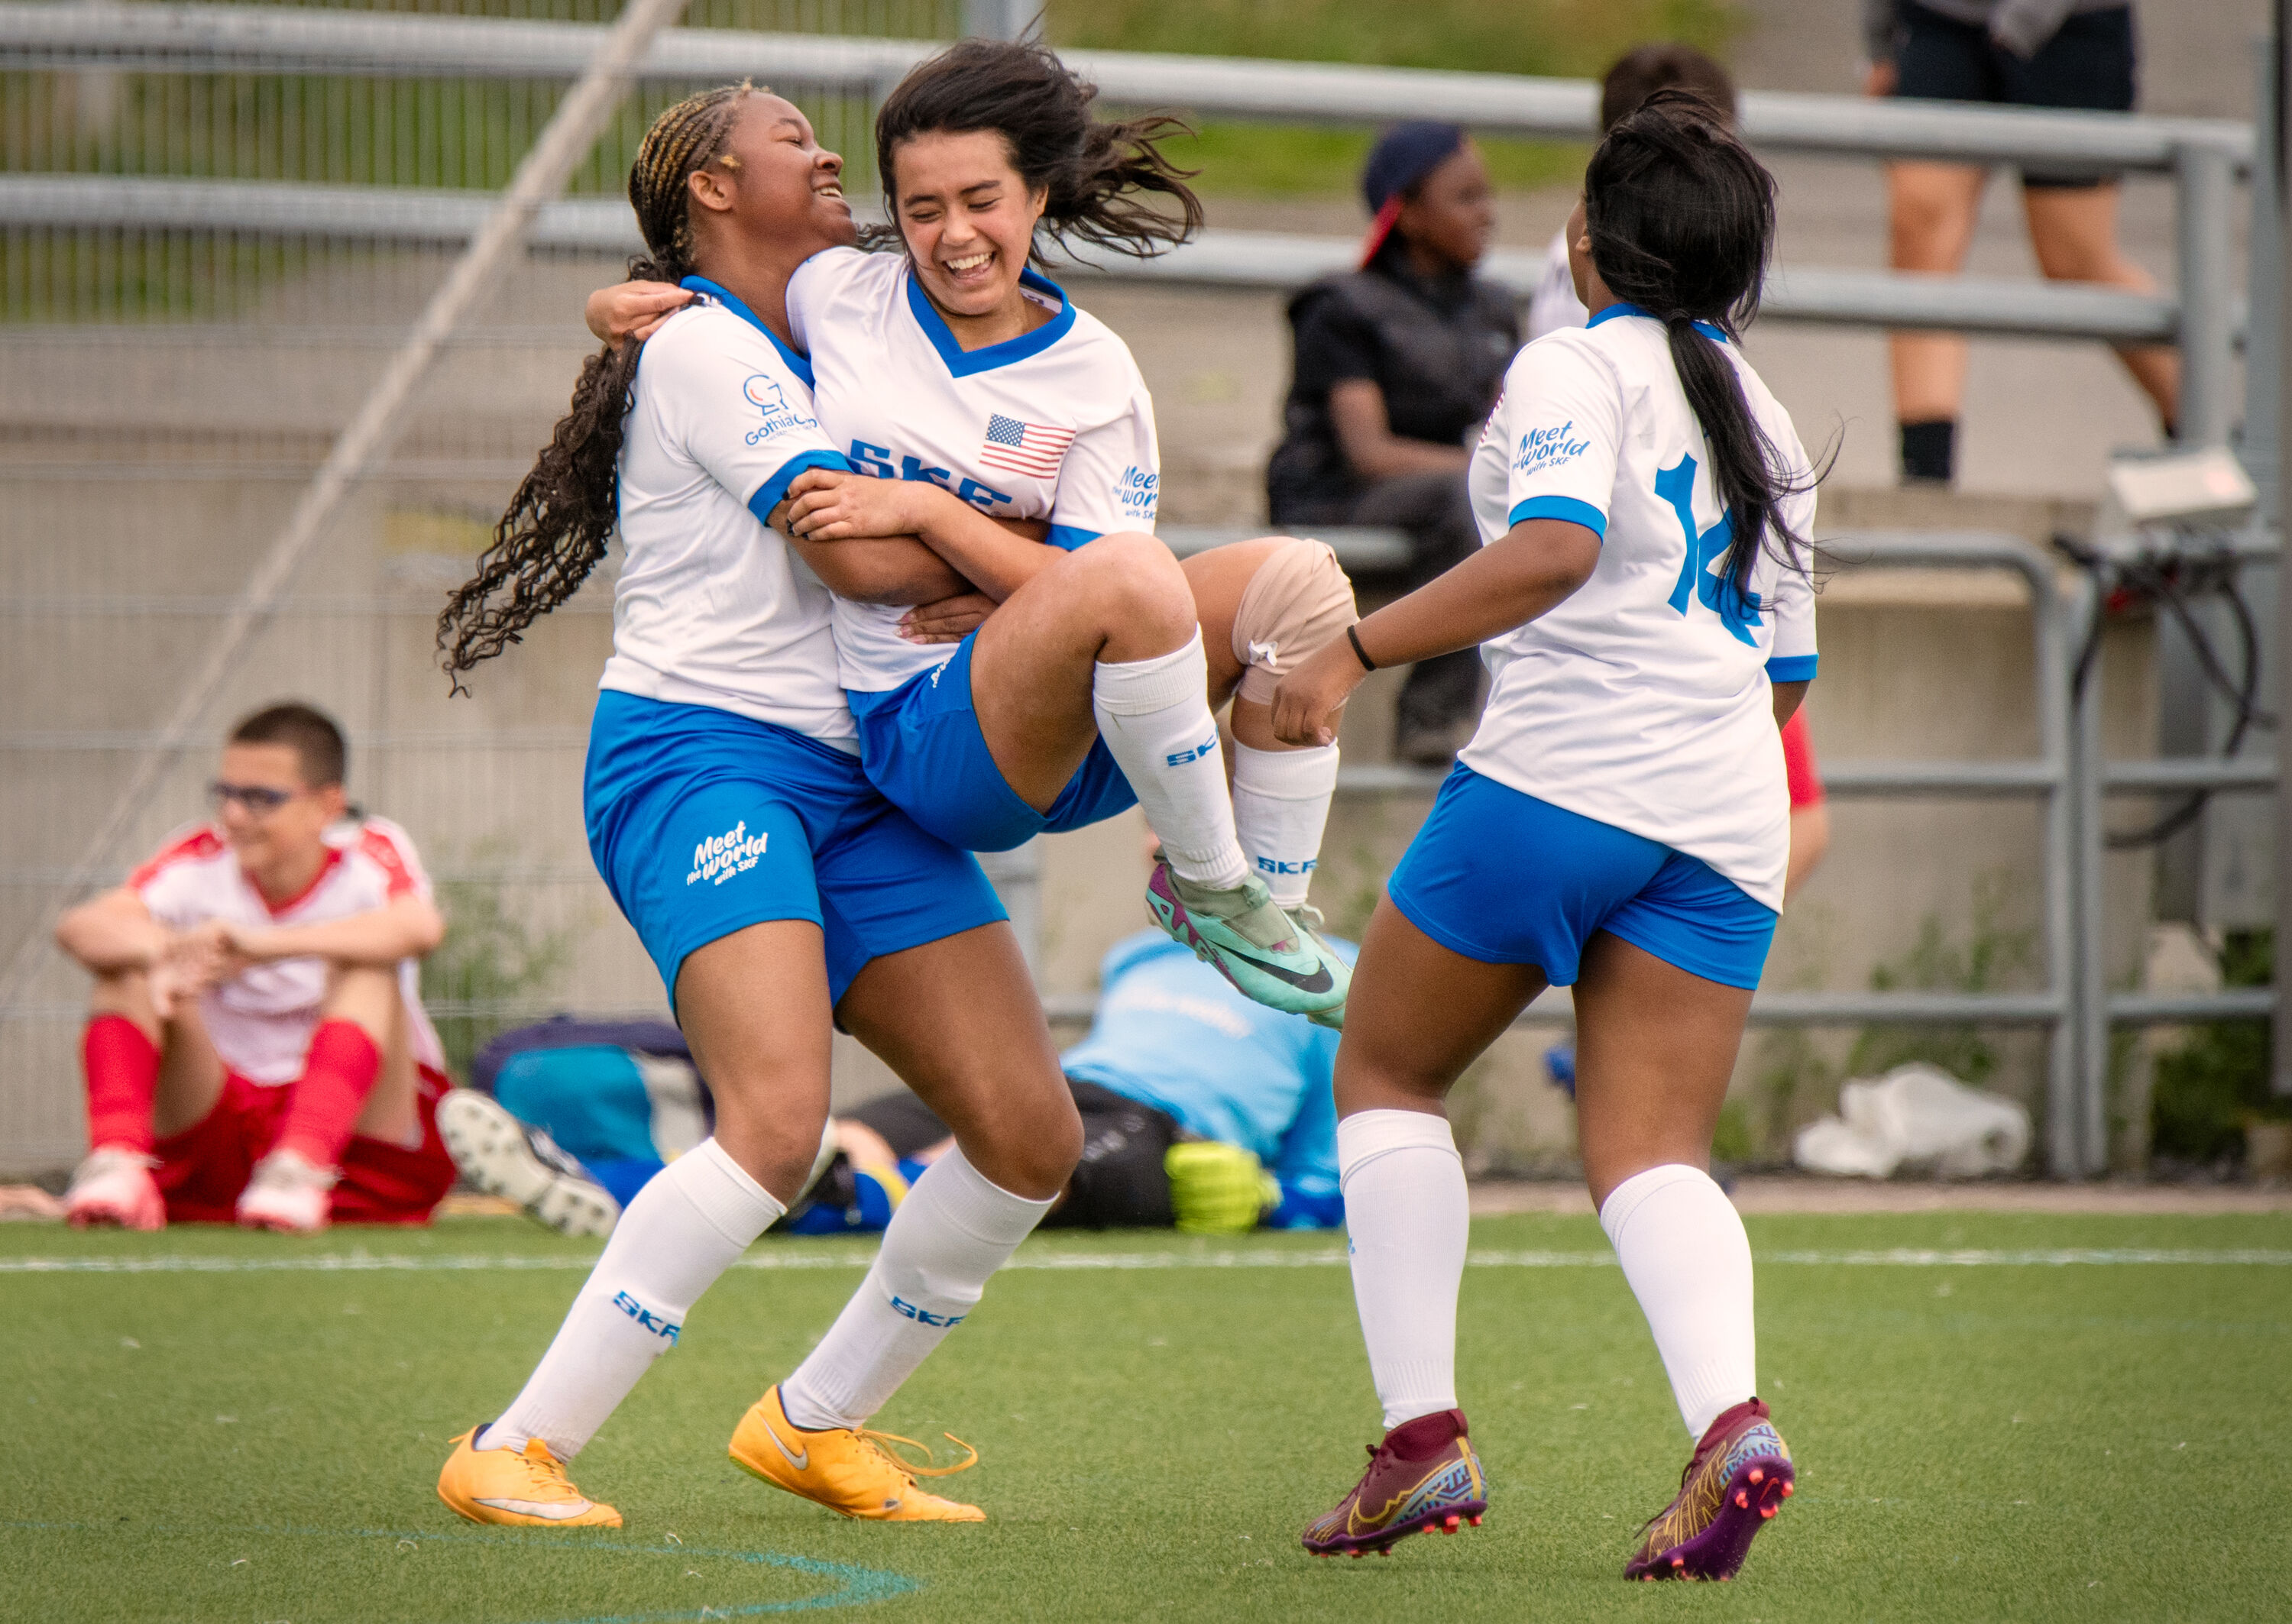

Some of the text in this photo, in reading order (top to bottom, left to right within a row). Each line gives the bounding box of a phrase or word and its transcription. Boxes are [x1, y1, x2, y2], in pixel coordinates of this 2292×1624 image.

[745, 415, 795, 445] Gothia
[1517, 420, 1572, 458] Meet
[1520, 438, 1591, 470] world
[1526, 457, 1571, 477] with SKF
[1122, 489, 1158, 507] wor
[1167, 723, 1219, 767] SK
[694, 820, 746, 870] Meet
[702, 832, 769, 881] world
[714, 856, 759, 886] with SKF
[1258, 856, 1318, 874] SKF
[613, 1290, 681, 1348] SKF
